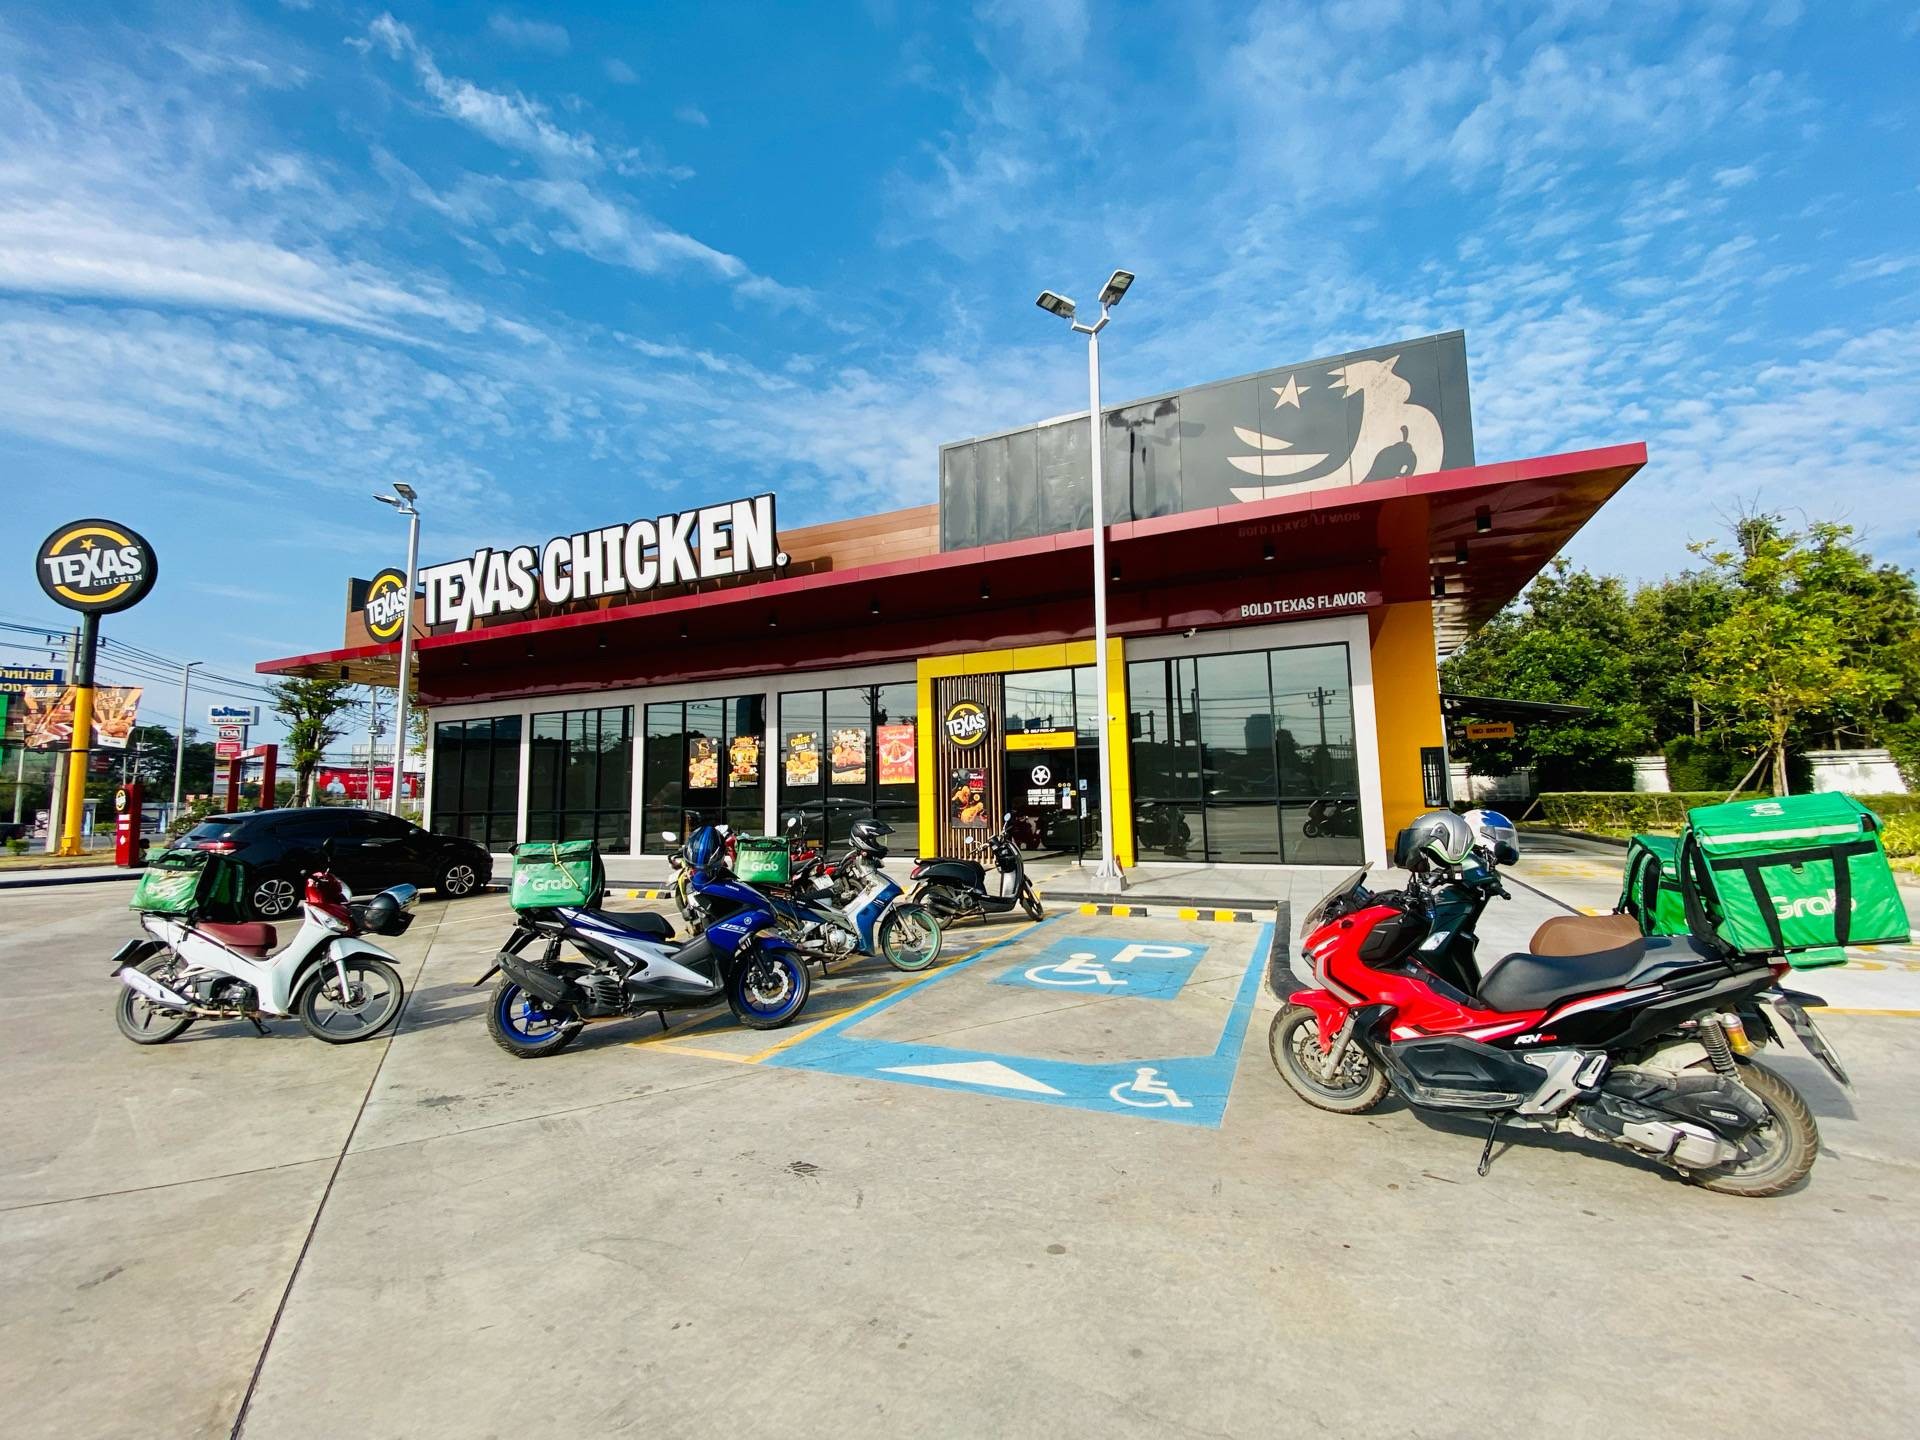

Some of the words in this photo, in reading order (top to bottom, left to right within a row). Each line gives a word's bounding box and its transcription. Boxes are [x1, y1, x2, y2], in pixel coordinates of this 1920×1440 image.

[44, 545, 142, 588] TEXAS
[423, 547, 543, 632] TEXAS
[547, 495, 774, 604] CHICKEN
[93, 574, 143, 586] CHICKEN
[366, 587, 407, 625] TEXAS
[1241, 603, 1272, 617] BOLD
[1274, 597, 1315, 613] TEXAS
[1318, 591, 1367, 609] FLAVOR
[946, 712, 986, 737] TEXAS
[751, 860, 779, 872] Grab
[532, 875, 573, 891] Grab
[1111, 944, 1193, 963] P
